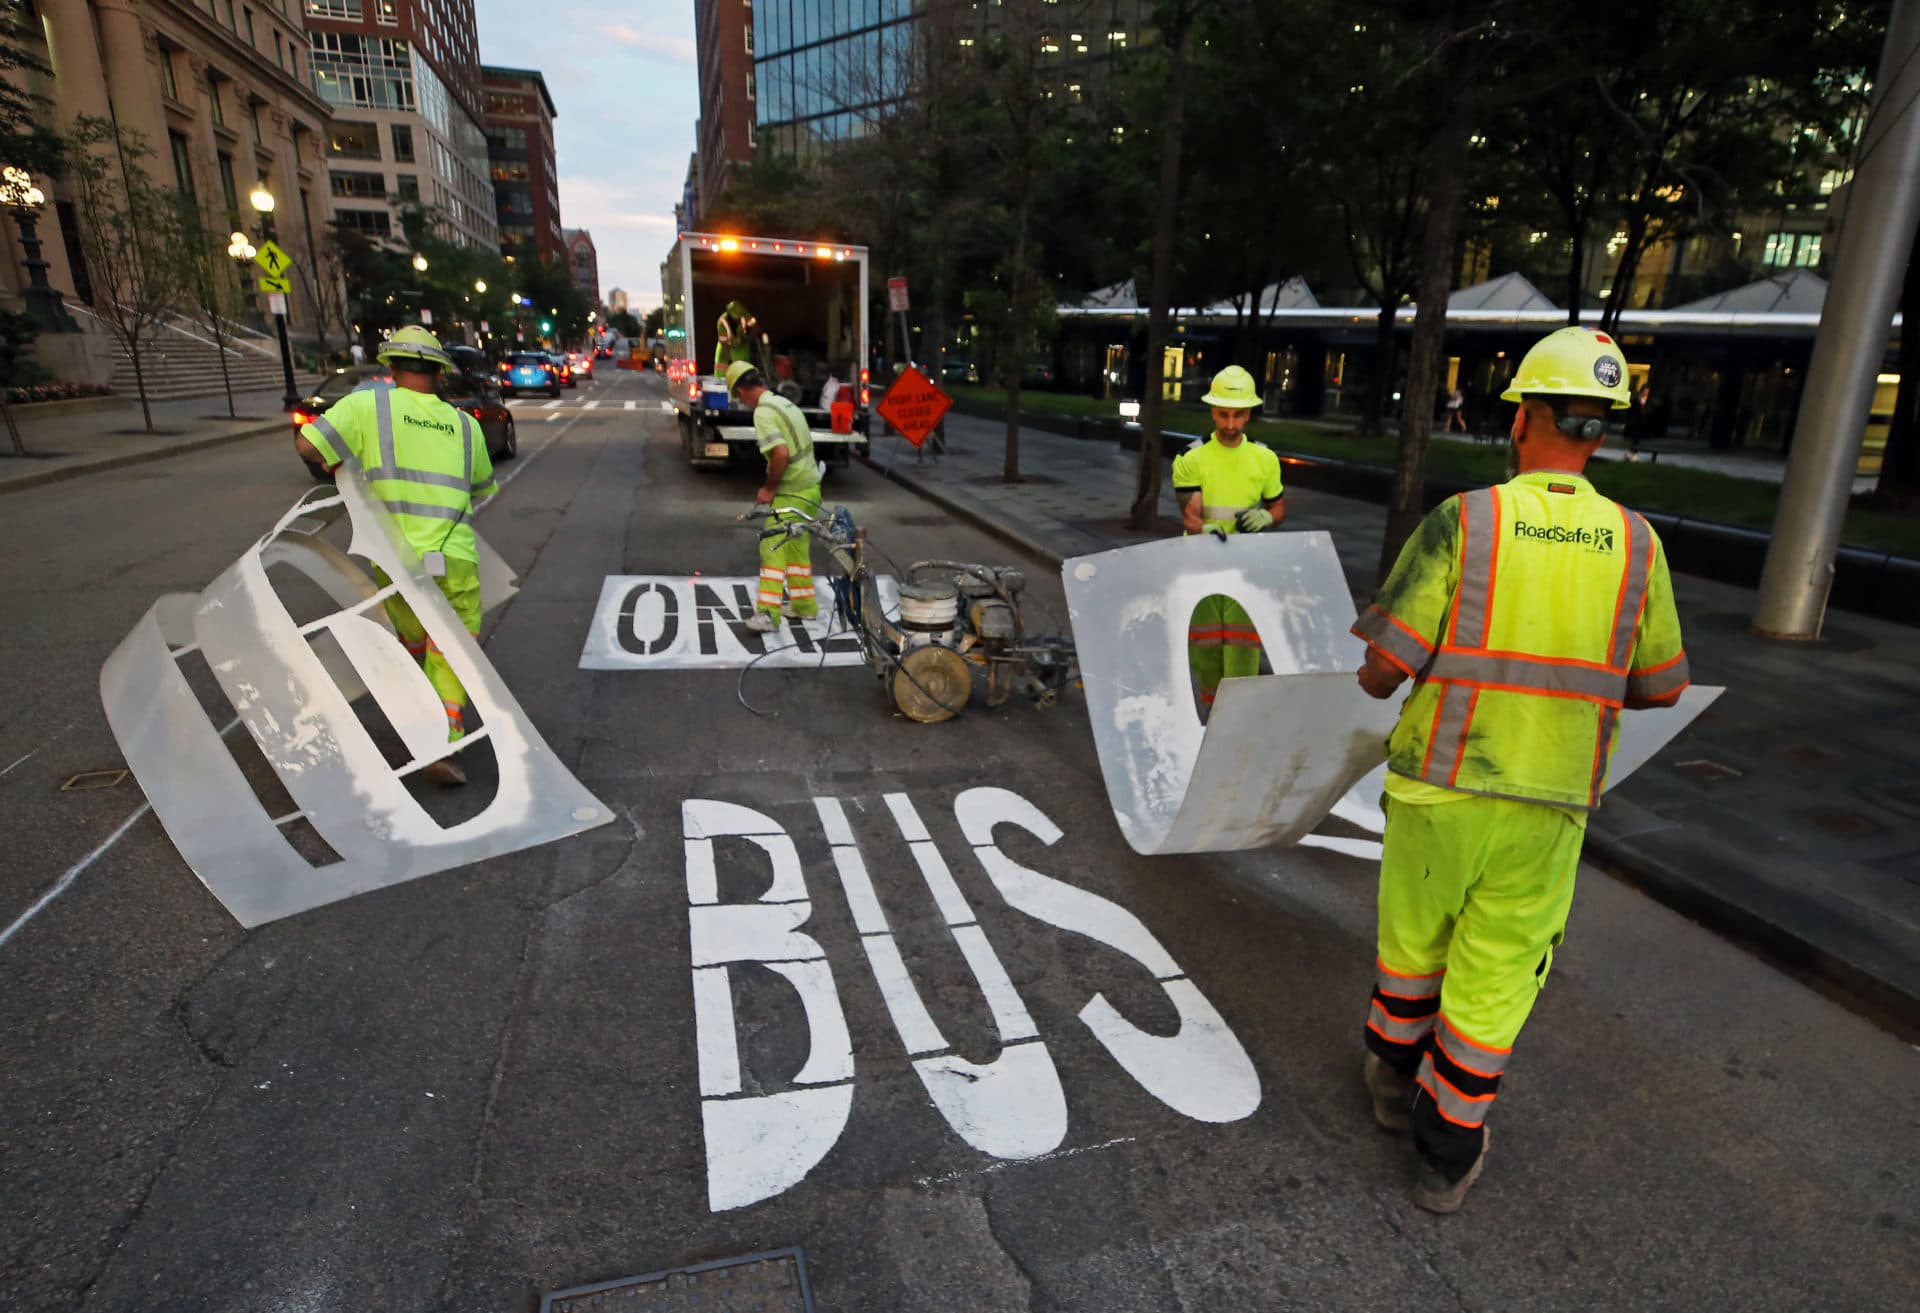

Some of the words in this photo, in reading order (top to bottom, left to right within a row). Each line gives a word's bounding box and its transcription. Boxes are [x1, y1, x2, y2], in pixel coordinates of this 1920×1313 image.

[916, 391, 936, 402] LANE
[898, 405, 931, 418] CLOSED
[403, 415, 445, 431] RoadSafe
[903, 419, 930, 431] AHEAD
[1515, 521, 1592, 544] RoadSafe
[617, 582, 866, 655] ONL
[682, 786, 1262, 1212] BUS
